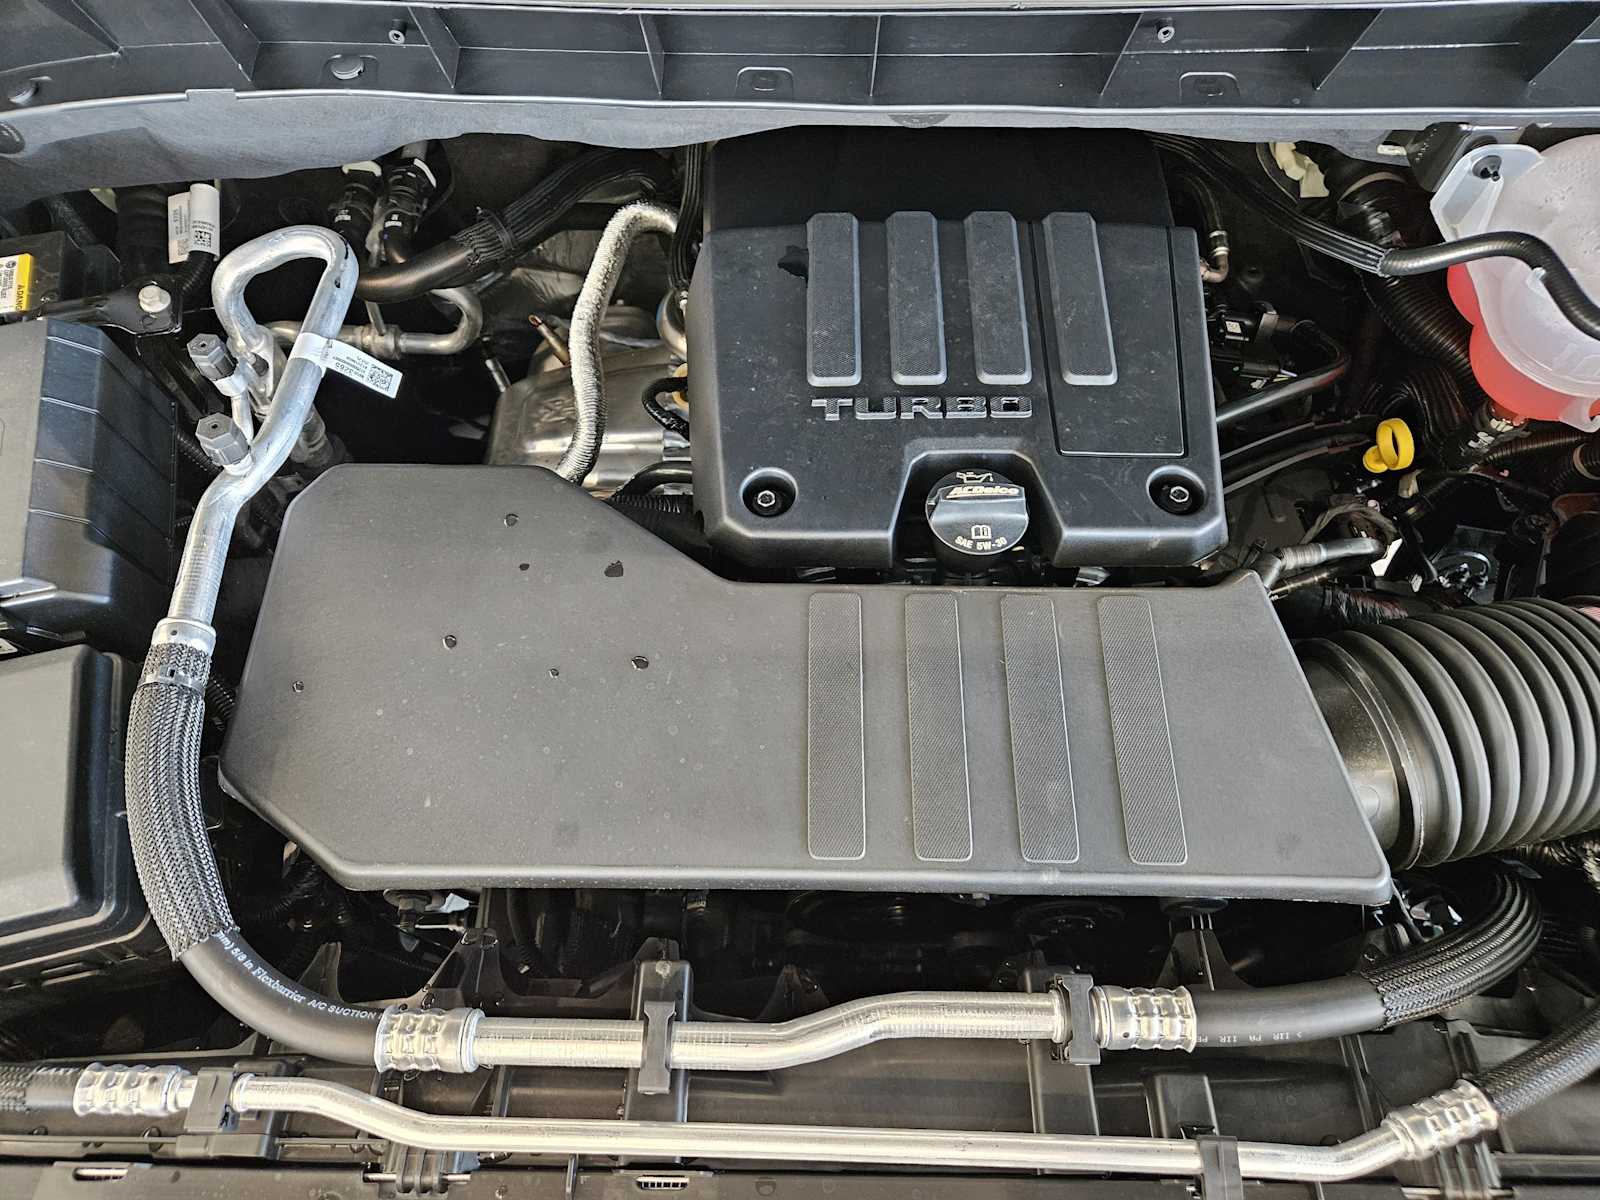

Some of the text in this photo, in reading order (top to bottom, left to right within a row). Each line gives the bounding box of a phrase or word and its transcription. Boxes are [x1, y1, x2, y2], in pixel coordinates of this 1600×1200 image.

[811, 397, 1032, 421] TURBO
[947, 485, 1020, 498] ACDelco
[954, 535, 1008, 551] SAE 5W-30
[231, 947, 247, 961] 5/8
[251, 966, 306, 1003] Flexbarrier
[307, 999, 327, 1010] A/C
[327, 1005, 377, 1019] SUCTION
